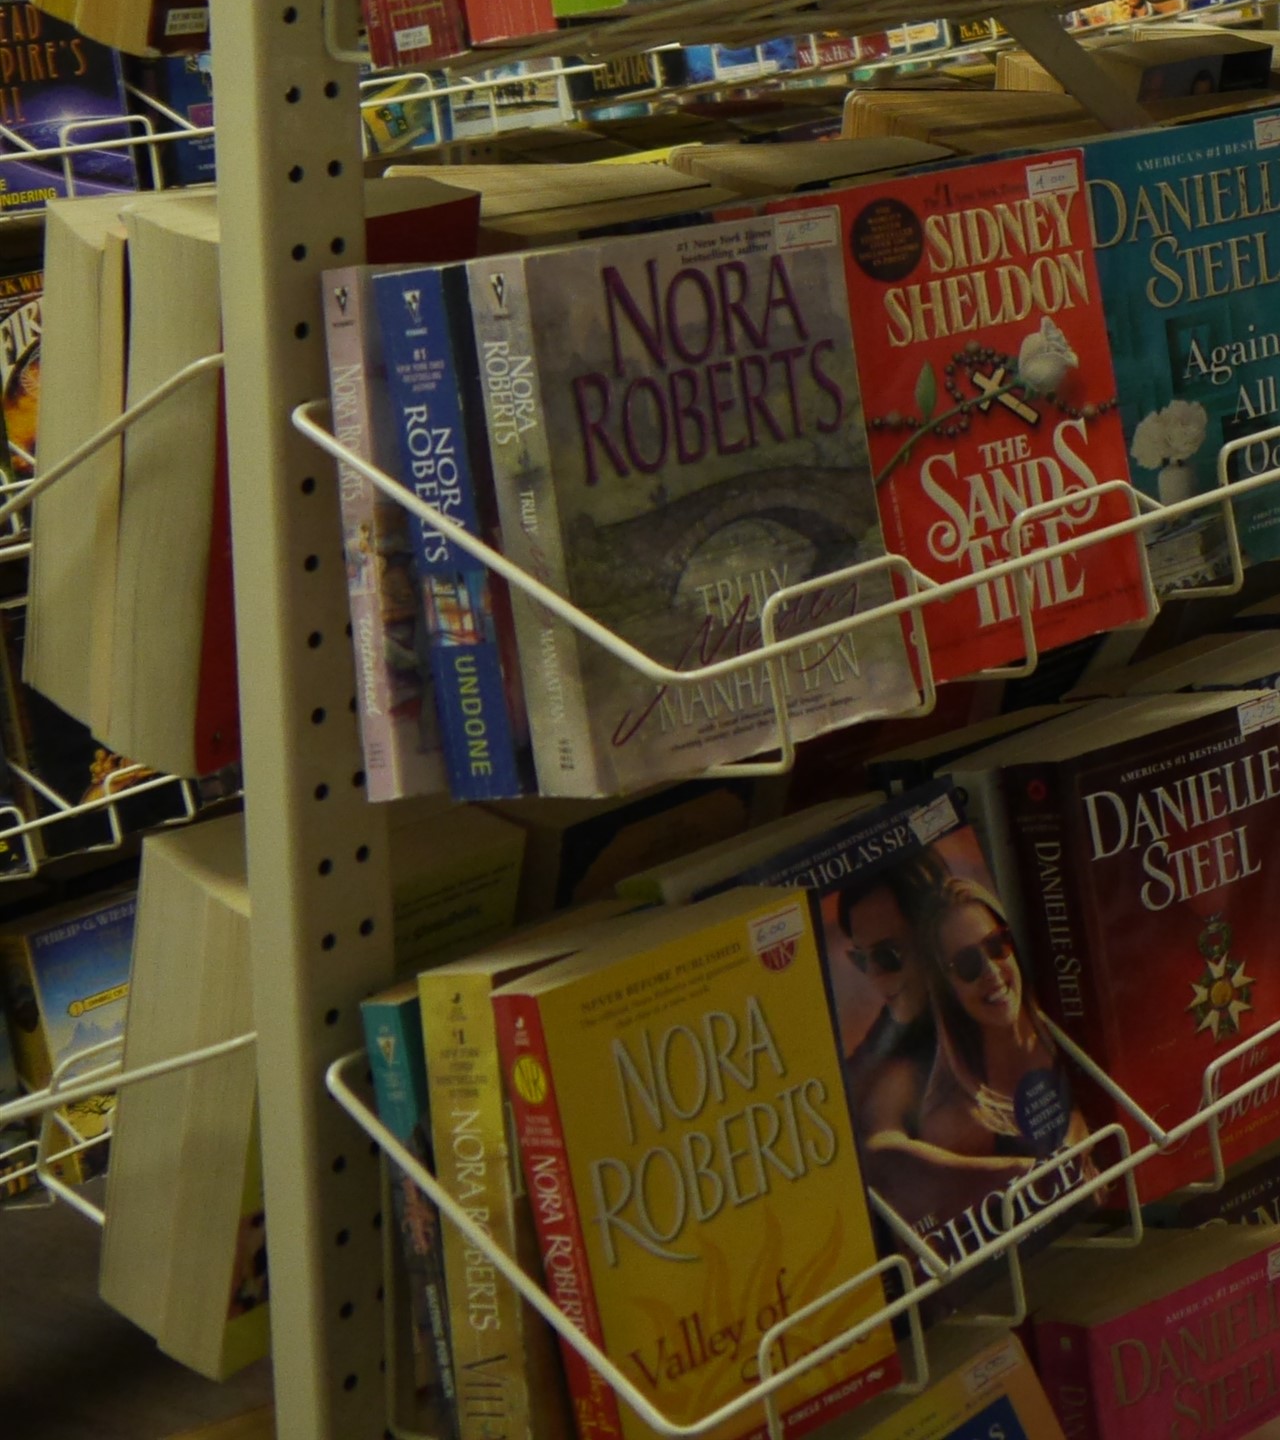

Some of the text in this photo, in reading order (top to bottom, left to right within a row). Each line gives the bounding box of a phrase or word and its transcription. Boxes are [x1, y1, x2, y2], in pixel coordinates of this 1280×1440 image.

[1136, 153, 1202, 172] AMERICA'S
[924, 192, 1077, 274] SIDNEY
[602, 254, 811, 377] NORA
[883, 251, 1090, 347] SHELDON
[509, 354, 538, 434] NORA
[571, 338, 846, 487] ROBERTS
[1232, 376, 1278, 424] All
[920, 417, 1100, 563] SANDS
[978, 434, 1032, 470] THE
[453, 654, 493, 779] UNDONE
[1119, 733, 1247, 784] AMERICA'S BESTSELLER
[1140, 825, 1262, 913] STEEL
[1033, 838, 1085, 1019] DANIELLE STEEL
[610, 994, 788, 1147] NORA
[590, 1076, 841, 1268] ROBERTS
[628, 1304, 746, 1394] Valley
